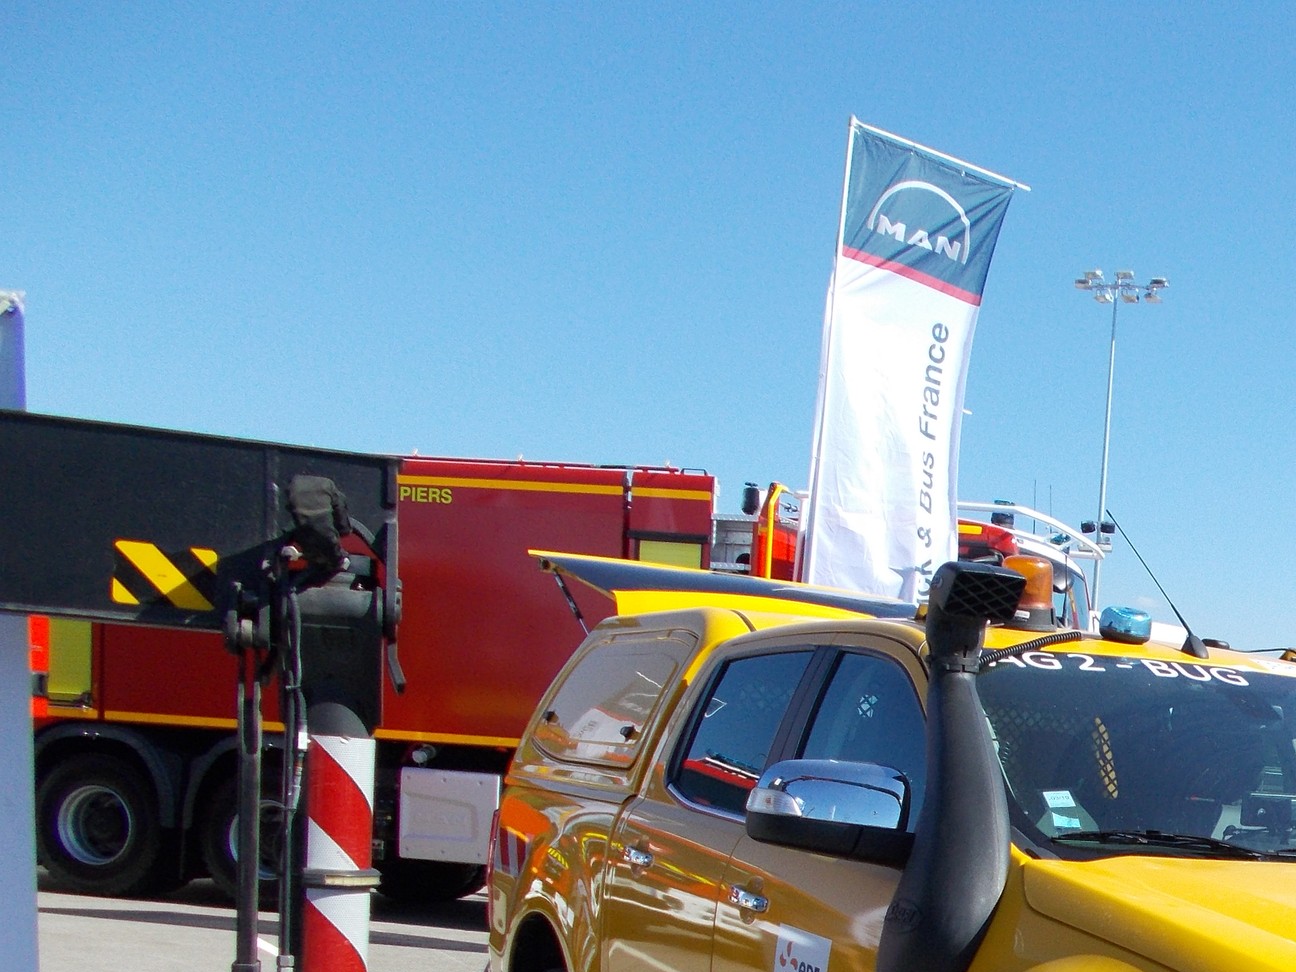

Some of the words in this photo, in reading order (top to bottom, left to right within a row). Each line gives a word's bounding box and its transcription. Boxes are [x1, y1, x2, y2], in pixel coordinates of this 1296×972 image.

[877, 214, 961, 262] MAN
[920, 321, 949, 441] France
[400, 486, 452, 504] PIERS
[919, 451, 934, 514] Bus
[1067, 654, 1106, 672] 2
[1140, 659, 1250, 687] BUG
